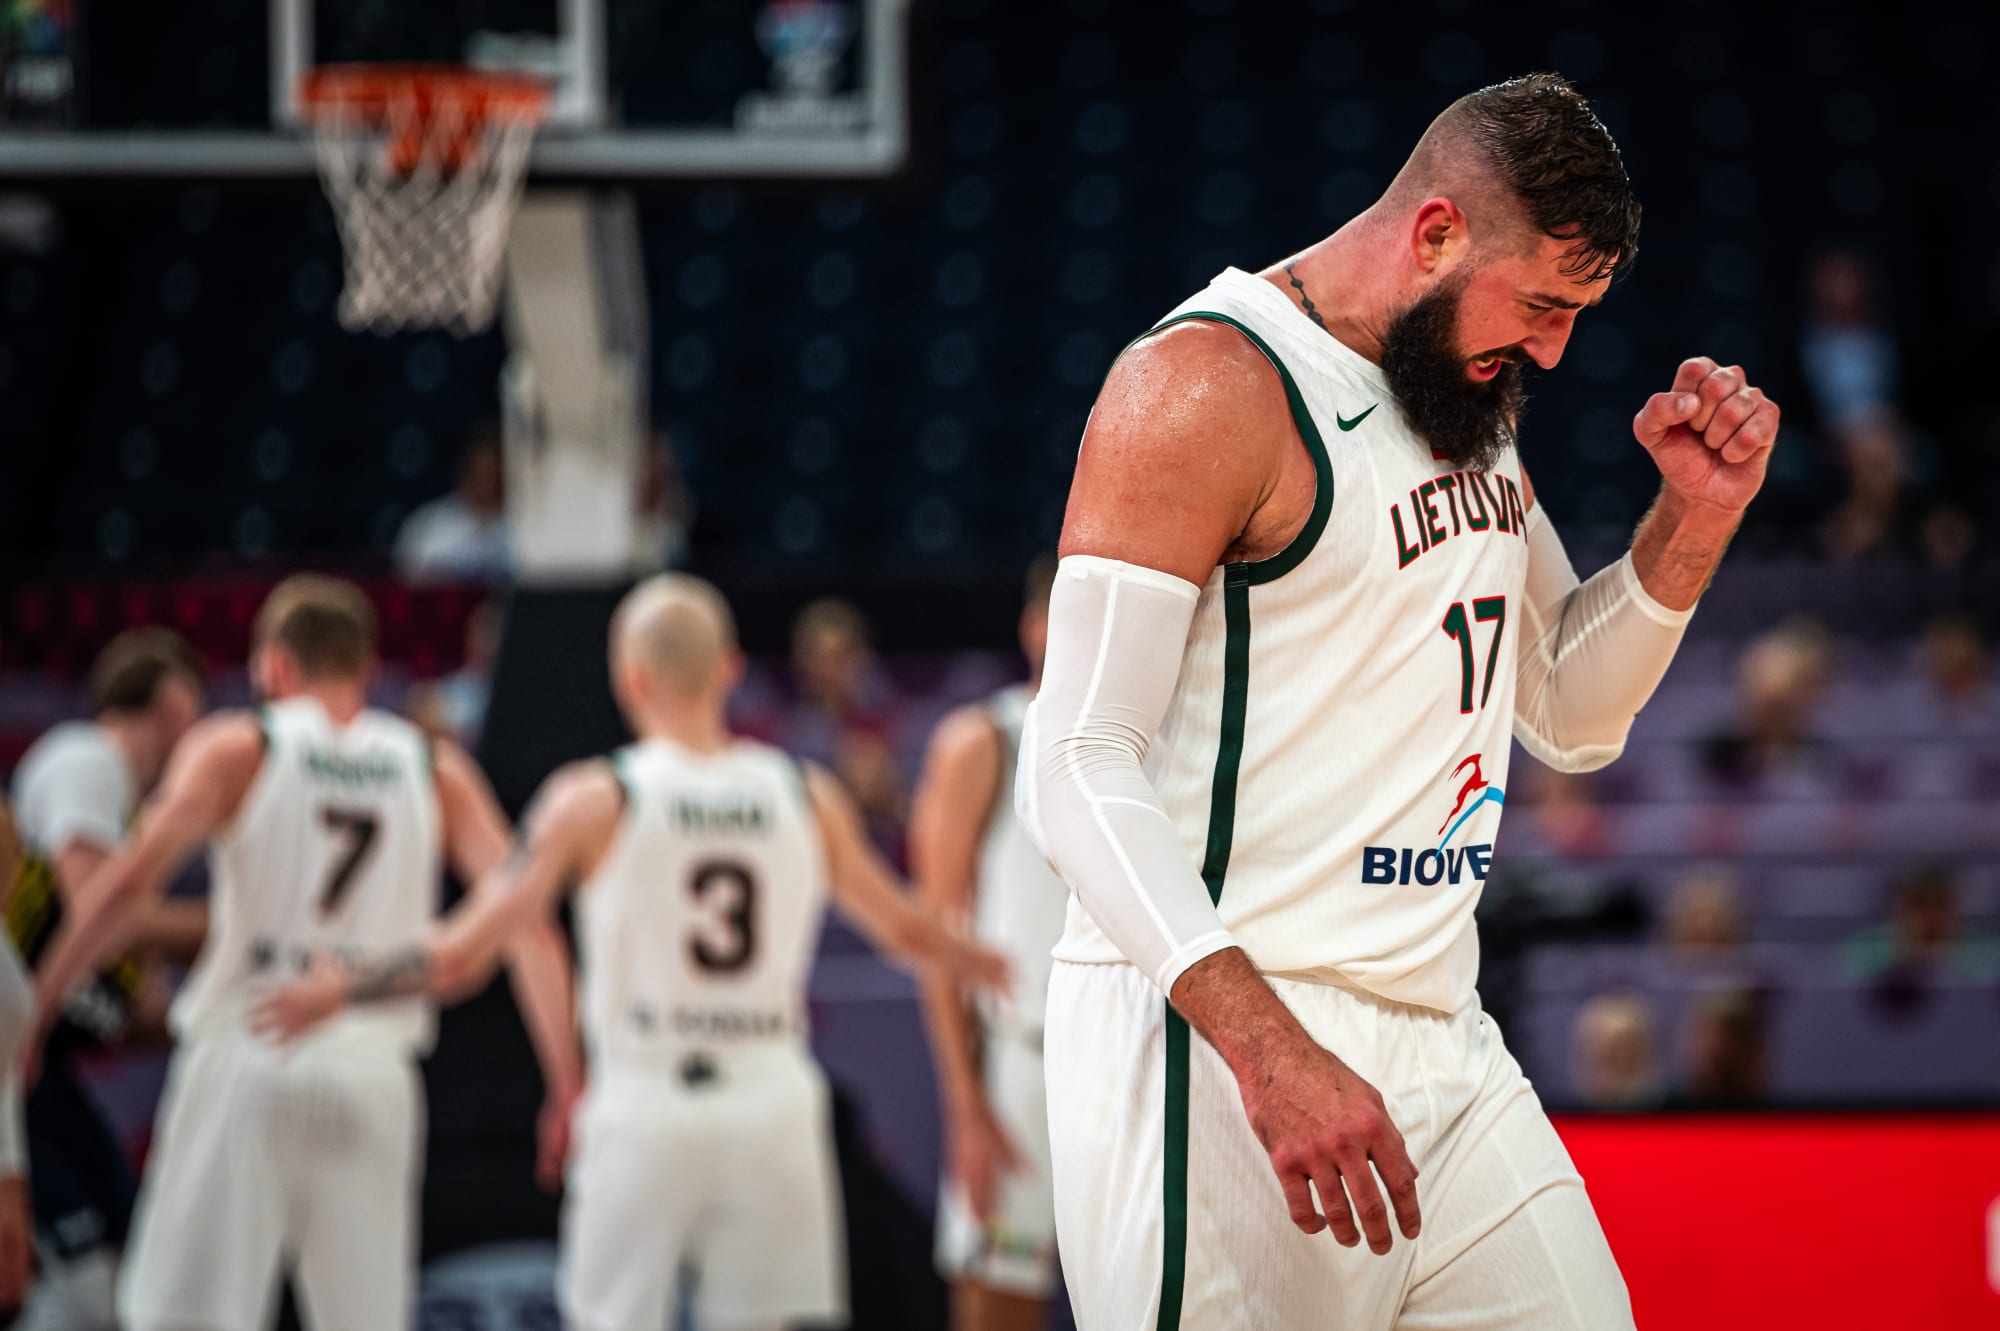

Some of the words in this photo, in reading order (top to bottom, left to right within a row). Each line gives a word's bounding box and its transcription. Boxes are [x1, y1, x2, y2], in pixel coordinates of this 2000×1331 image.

[1390, 471, 1528, 570] LIETUVA
[1442, 595, 1505, 715] 17
[315, 805, 382, 920] 7
[685, 856, 759, 977] 3
